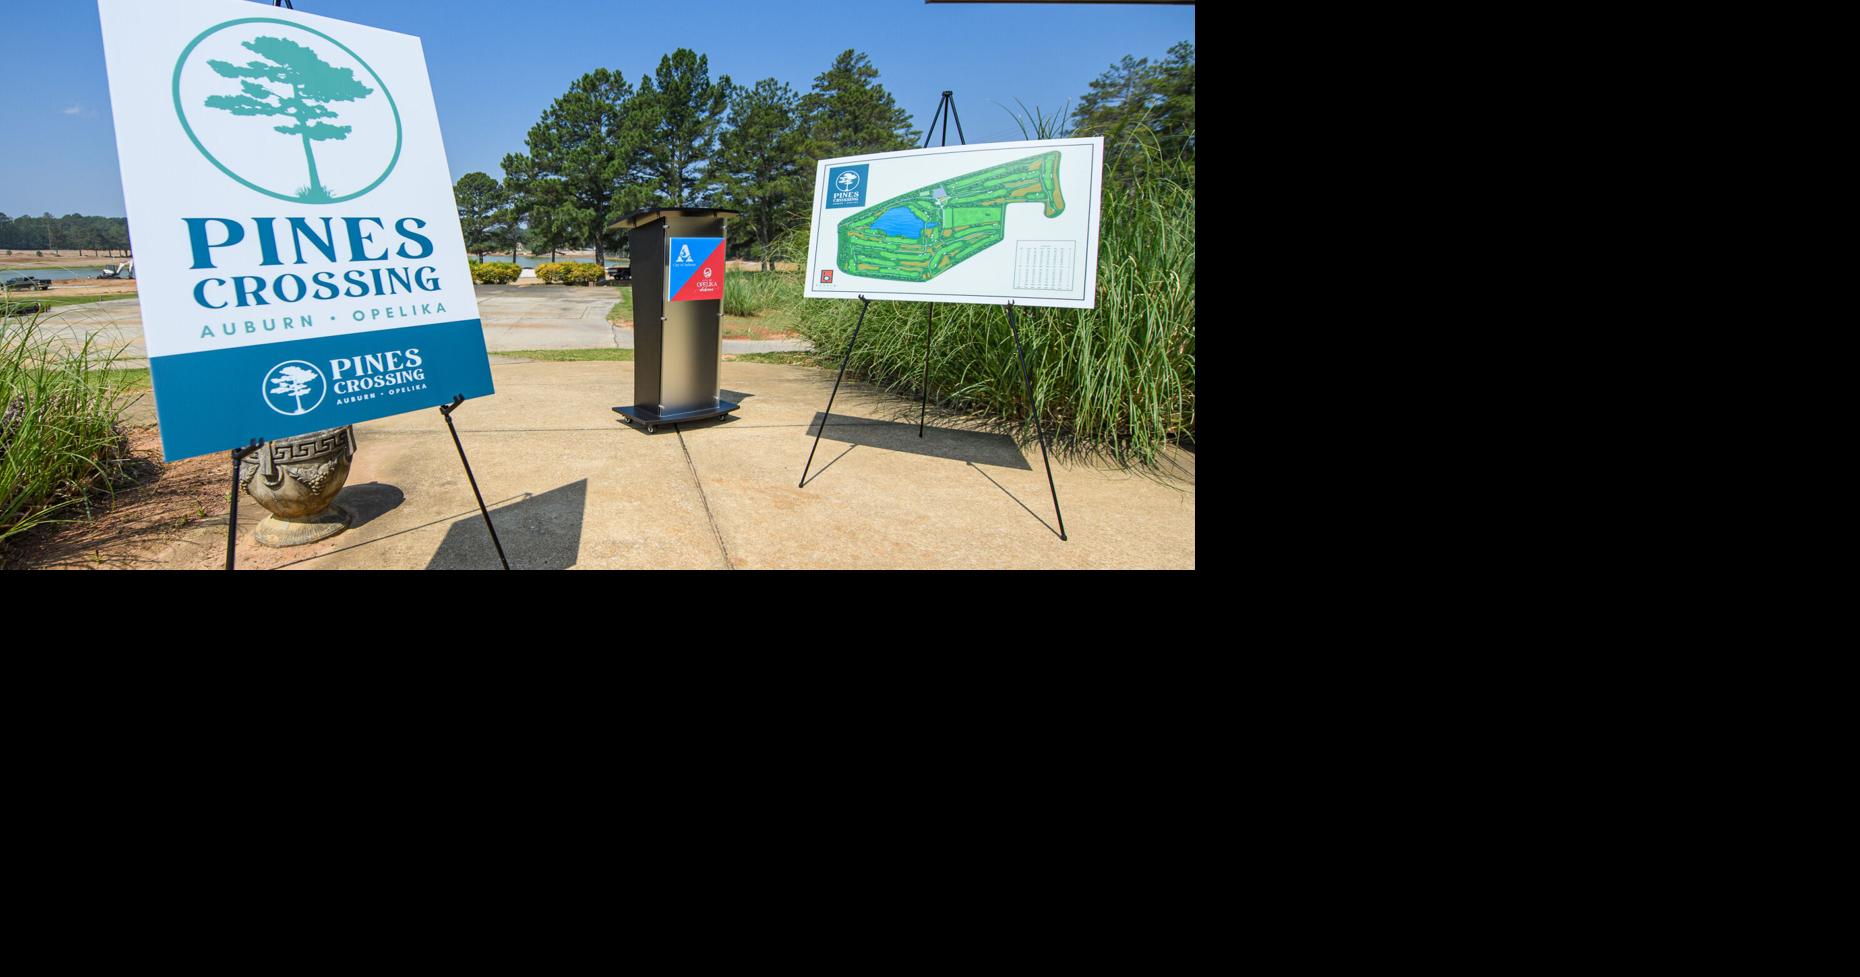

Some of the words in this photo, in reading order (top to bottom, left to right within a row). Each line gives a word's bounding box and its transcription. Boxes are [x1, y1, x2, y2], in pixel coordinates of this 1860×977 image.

[833, 191, 860, 199] PINES
[181, 217, 434, 269] PINES
[193, 266, 442, 309] CROSSING
[200, 315, 313, 338] AUBURN
[352, 302, 446, 322] OPELIKA
[329, 348, 422, 380] PINES
[333, 368, 425, 395] CROSSING
[336, 393, 376, 405] AUBURN
[388, 383, 427, 396] OPELIKA
